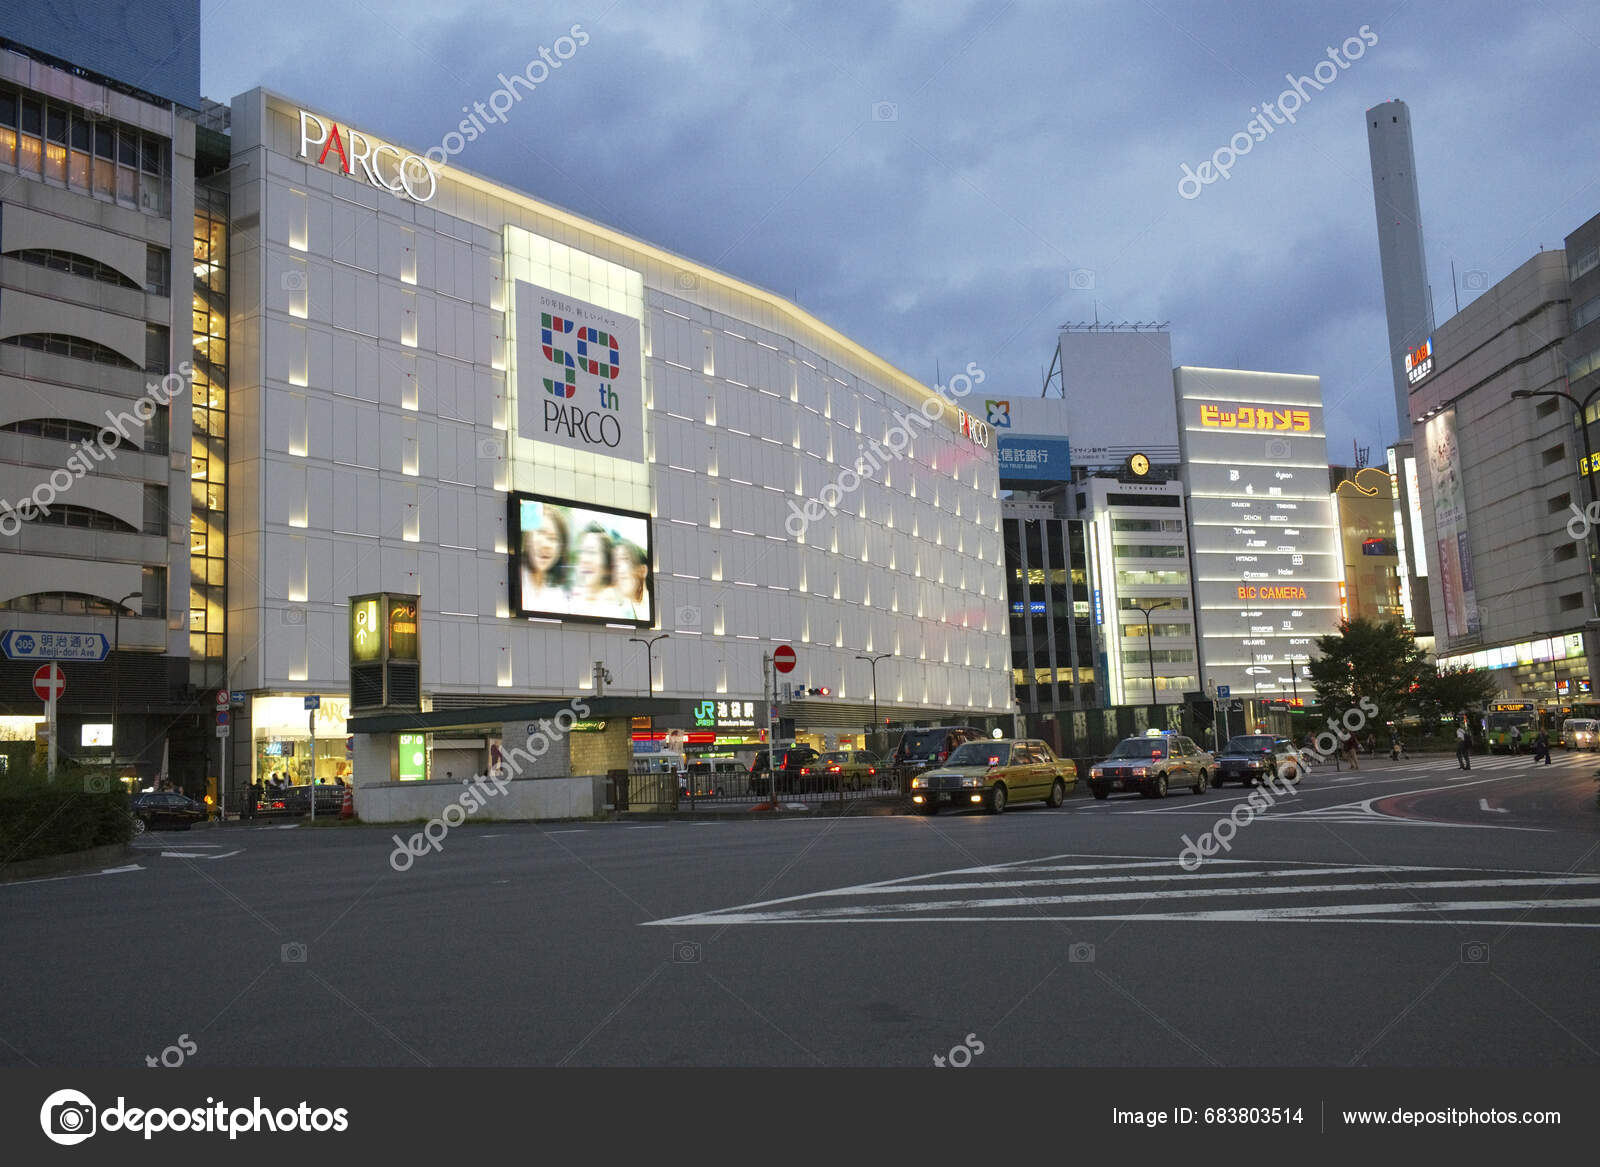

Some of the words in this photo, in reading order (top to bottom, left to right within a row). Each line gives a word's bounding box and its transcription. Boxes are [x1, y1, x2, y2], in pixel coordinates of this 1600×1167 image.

[298, 109, 436, 202] PARCO
[544, 399, 621, 448] PARCO
[1200, 404, 1311, 431] ビックカメラ
[958, 408, 989, 448] PARCO
[1237, 586, 1257, 599] BIC
[1260, 586, 1307, 599] CAMERA
[17, 640, 33, 649] 305
[41, 634, 95, 648] 明治通り
[40, 647, 78, 657] Meiji-dori
[81, 648, 97, 657] Ave.
[694, 701, 714, 719] JR
[717, 701, 754, 718] 池袋駅
